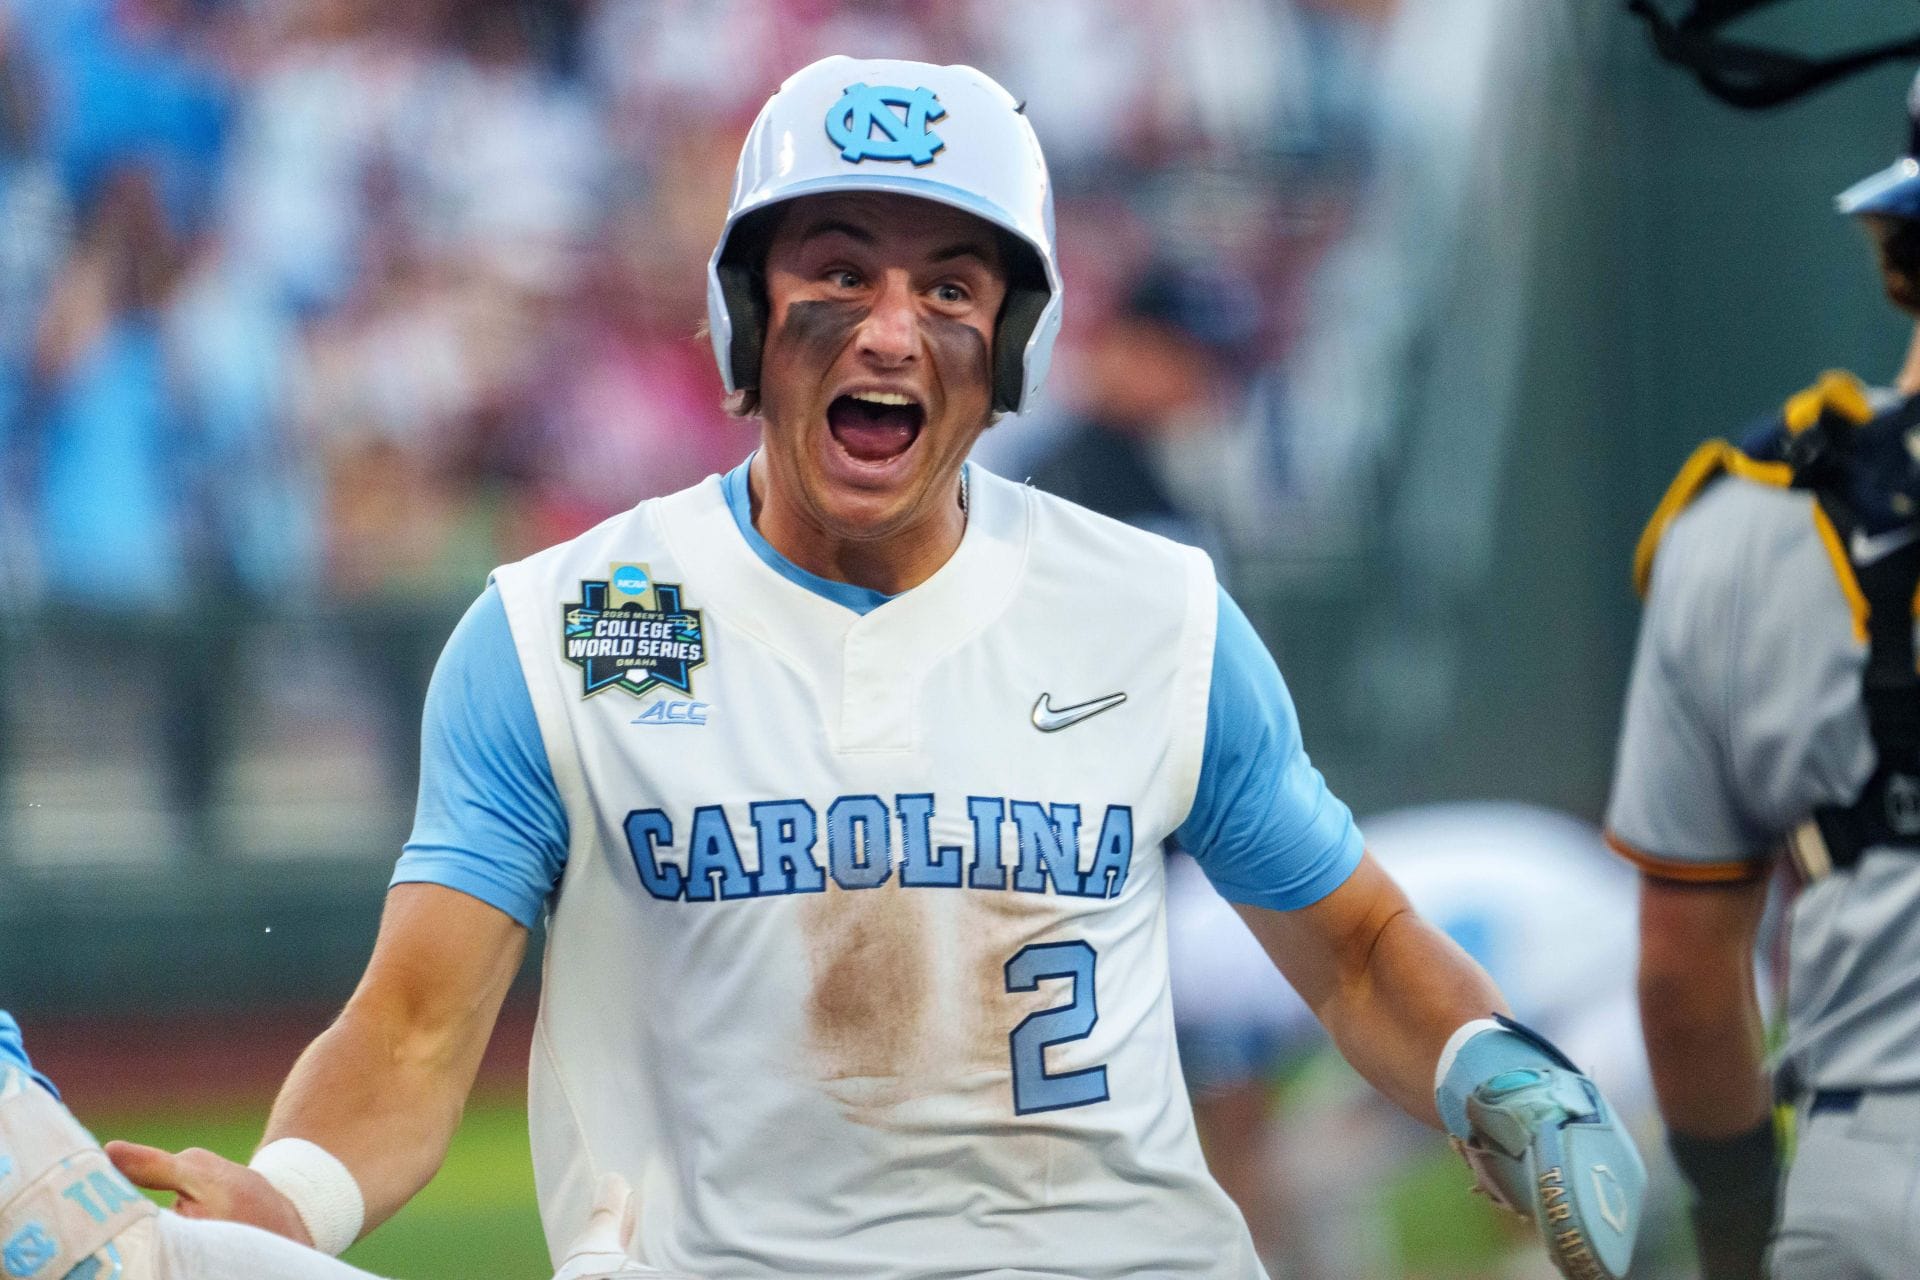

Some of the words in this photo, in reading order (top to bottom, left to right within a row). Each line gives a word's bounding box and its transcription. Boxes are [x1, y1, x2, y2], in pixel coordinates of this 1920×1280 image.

[616, 579, 648, 589] NCAA
[633, 612, 665, 621] MEN'S
[595, 620, 673, 640] COLLEGE
[568, 639, 634, 658] WORLD
[637, 641, 702, 661] SERIES
[616, 659, 657, 667] OMAHA
[637, 700, 712, 721] ACC
[623, 792, 1134, 902] CAROLINA
[1003, 939, 1110, 1116] 2
[1539, 1166, 1571, 1224] TAR
